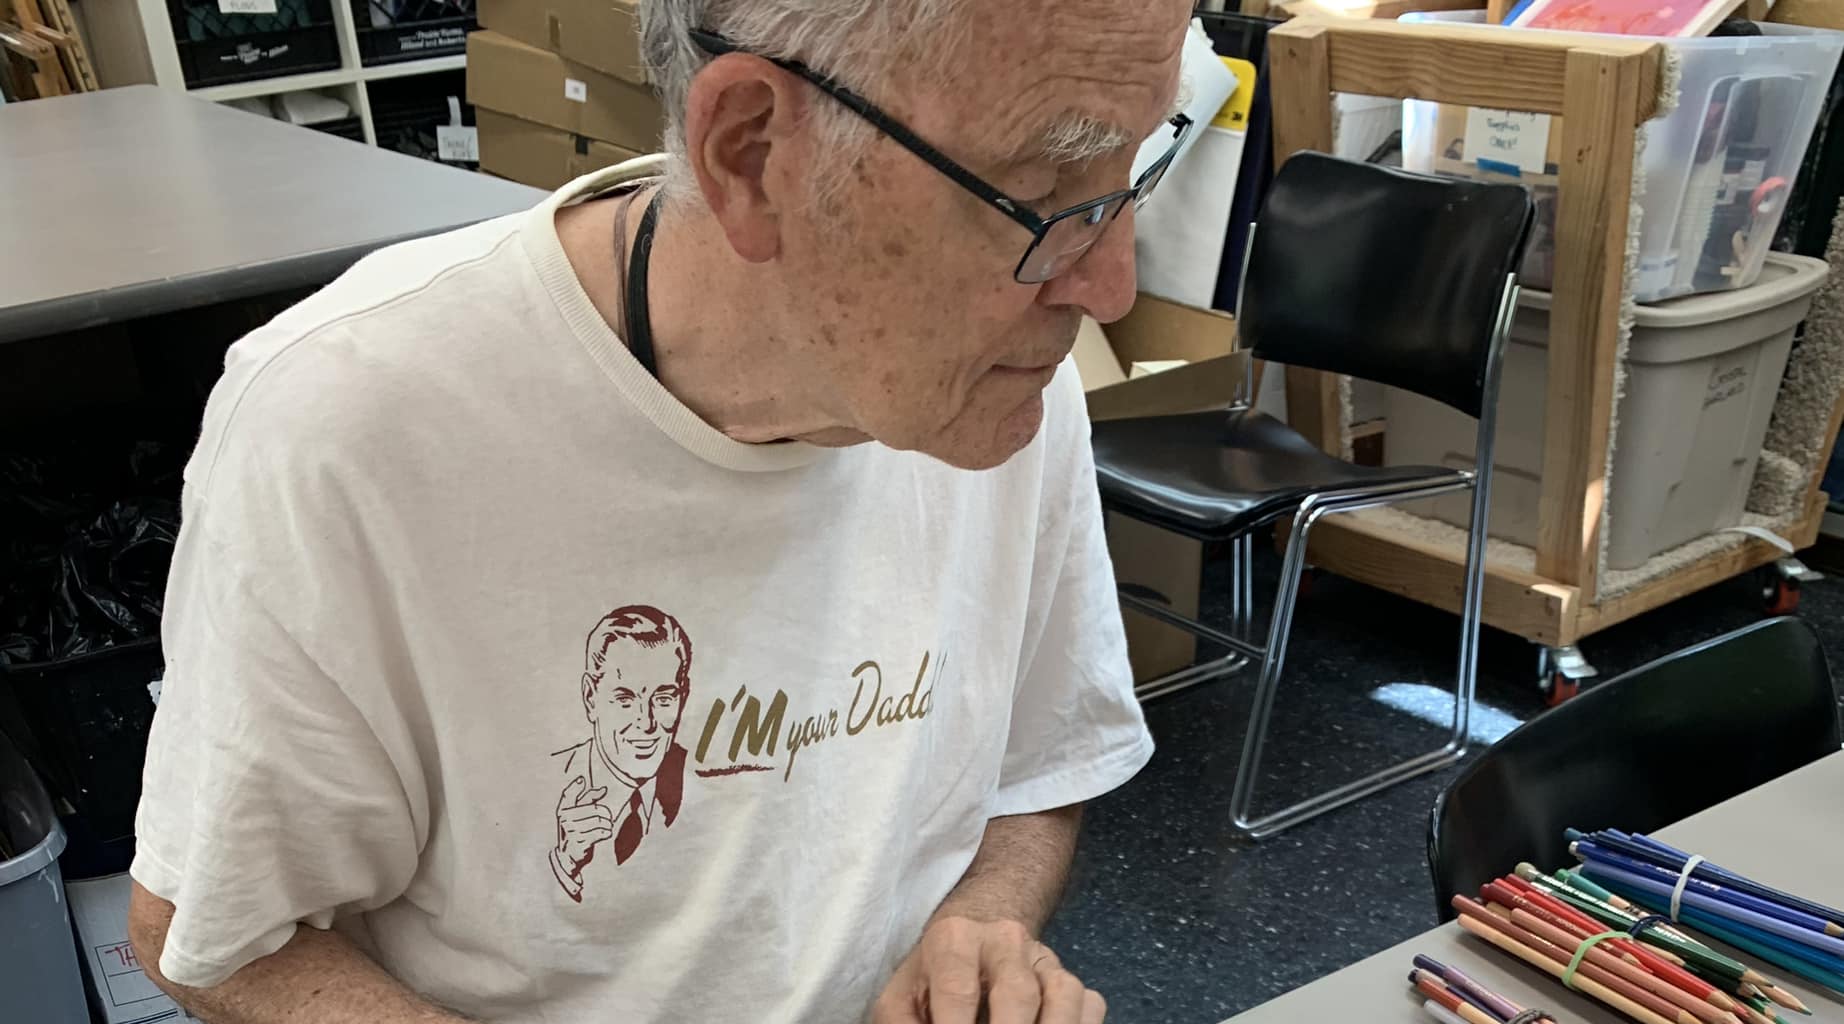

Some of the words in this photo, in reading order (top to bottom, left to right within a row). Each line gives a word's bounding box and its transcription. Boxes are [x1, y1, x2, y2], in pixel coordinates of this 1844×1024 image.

[694, 683, 788, 764] I'M
[784, 708, 839, 783] your
[846, 650, 947, 736] Dadd
